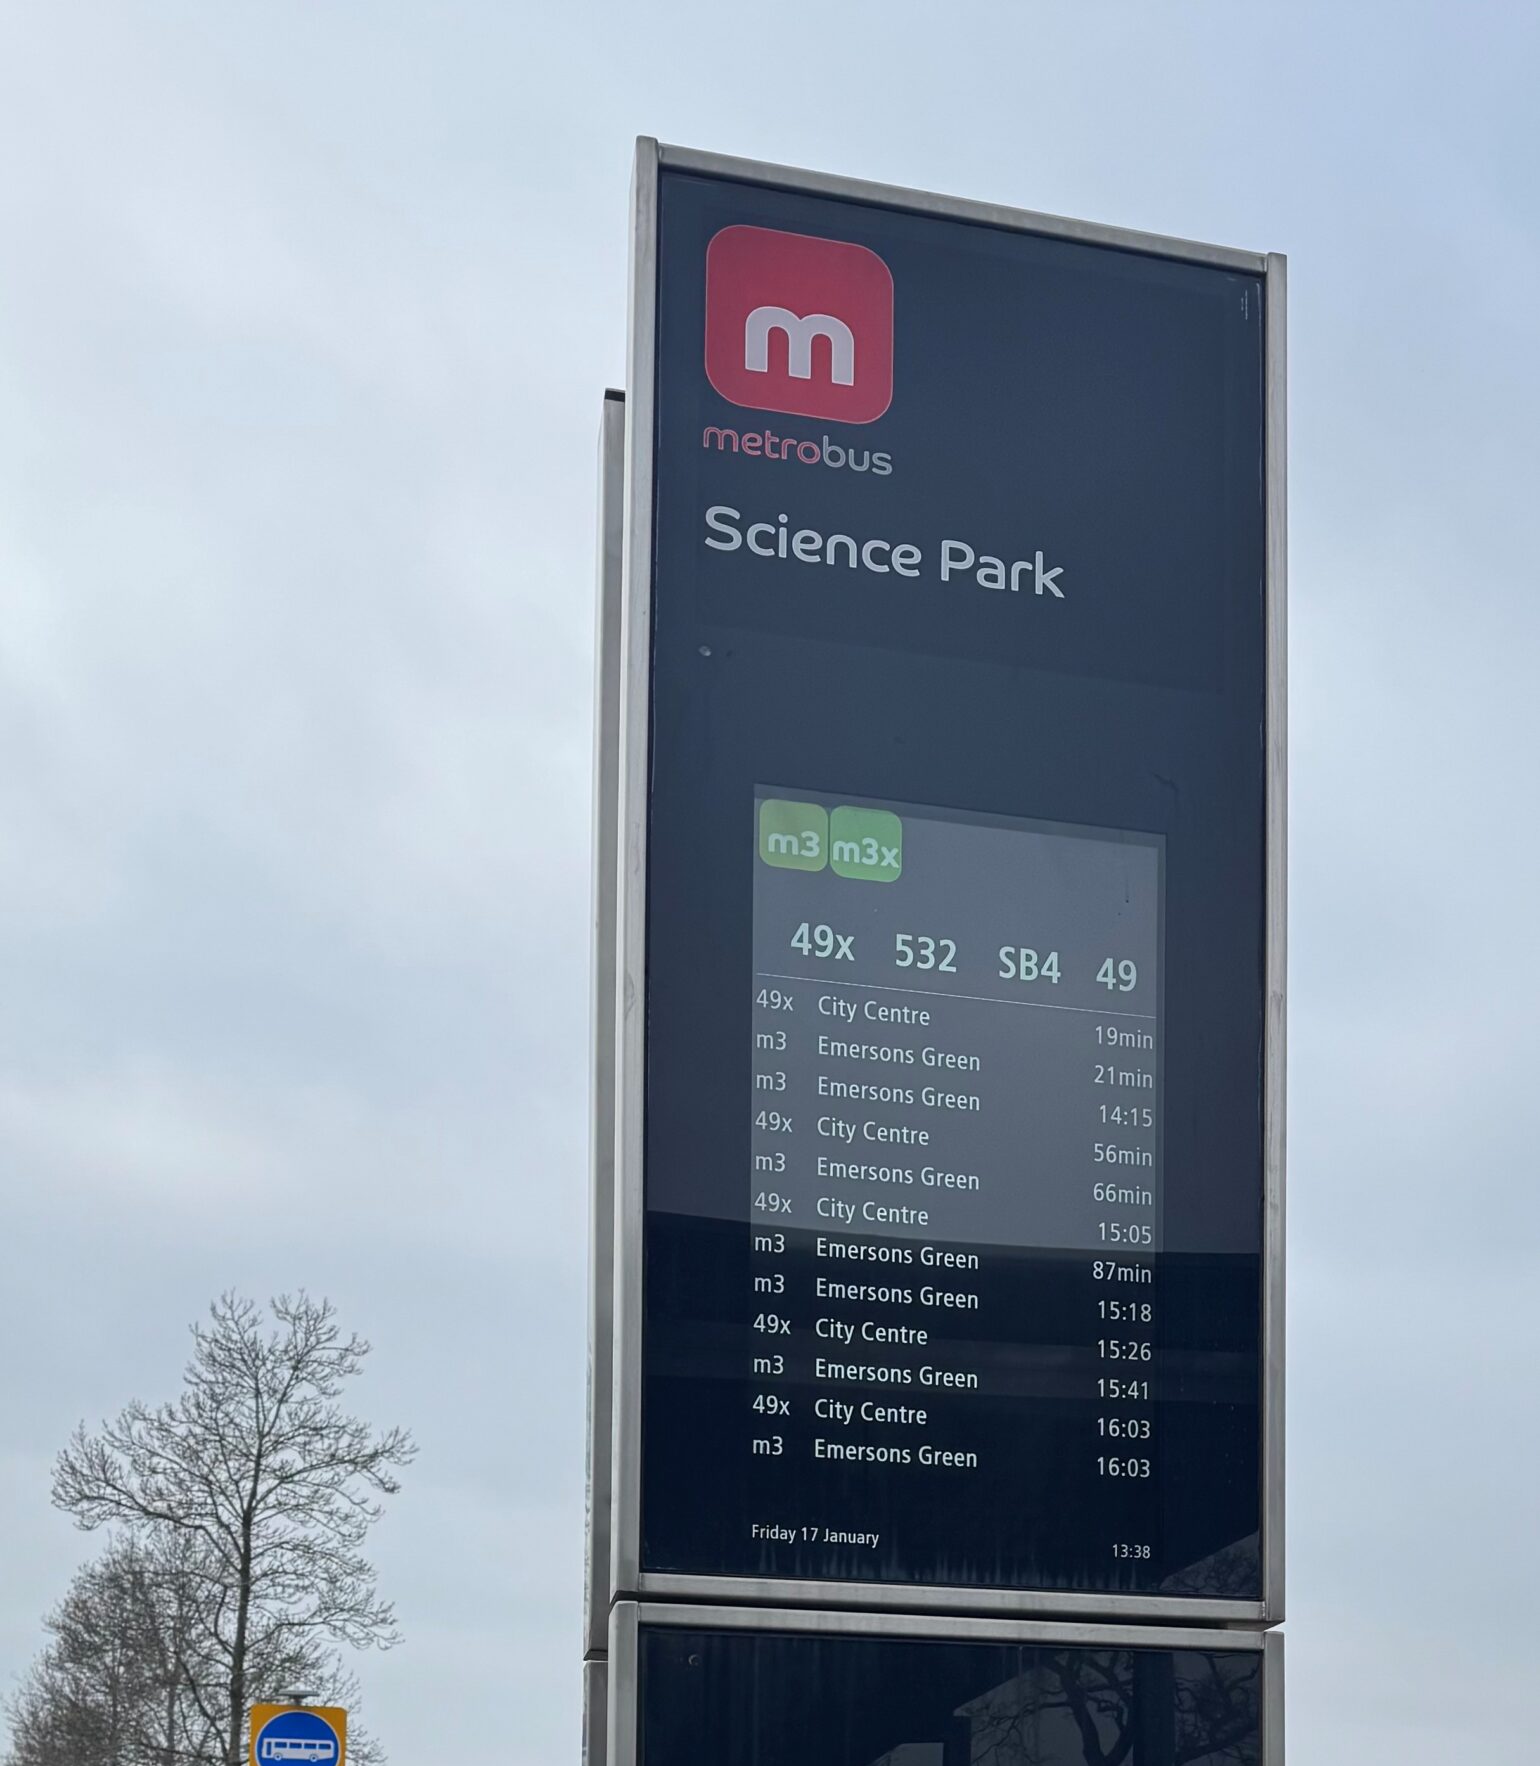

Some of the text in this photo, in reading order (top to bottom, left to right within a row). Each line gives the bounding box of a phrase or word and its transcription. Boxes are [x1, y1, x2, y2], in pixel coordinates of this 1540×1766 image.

[744, 305, 855, 387] m
[703, 426, 893, 476] metrobus
[704, 505, 1065, 599] Science Park
[768, 830, 900, 869] m3 m3x
[790, 922, 1137, 992] 49x 532 SB4 49
[756, 988, 1153, 1050] 49x City Centre 19min
[756, 1031, 1153, 1089] m3 Emersons Green 21min
[756, 1071, 1153, 1127] m3 Emersons Green 14:15
[755, 1110, 1152, 1167] 49x City Centre 56min
[755, 1152, 1152, 1206] m3 Emersons Green 66min
[754, 1191, 1152, 1245] 49x City Centre 15:05
[754, 1233, 1152, 1284] m3 Emersons Green 87min
[754, 1274, 1152, 1323] m3 Emersons Green 15:18
[753, 1313, 1152, 1361] 49x City Centre 15:26
[753, 1354, 1148, 1400] m3 Emersons Green 15:41
[752, 1394, 1151, 1439] 49x City Centre 16:03
[752, 1435, 1150, 1478] m3 Emersons Green 16:03
[752, 1524, 1151, 1559] Friday 17 January 13:38
